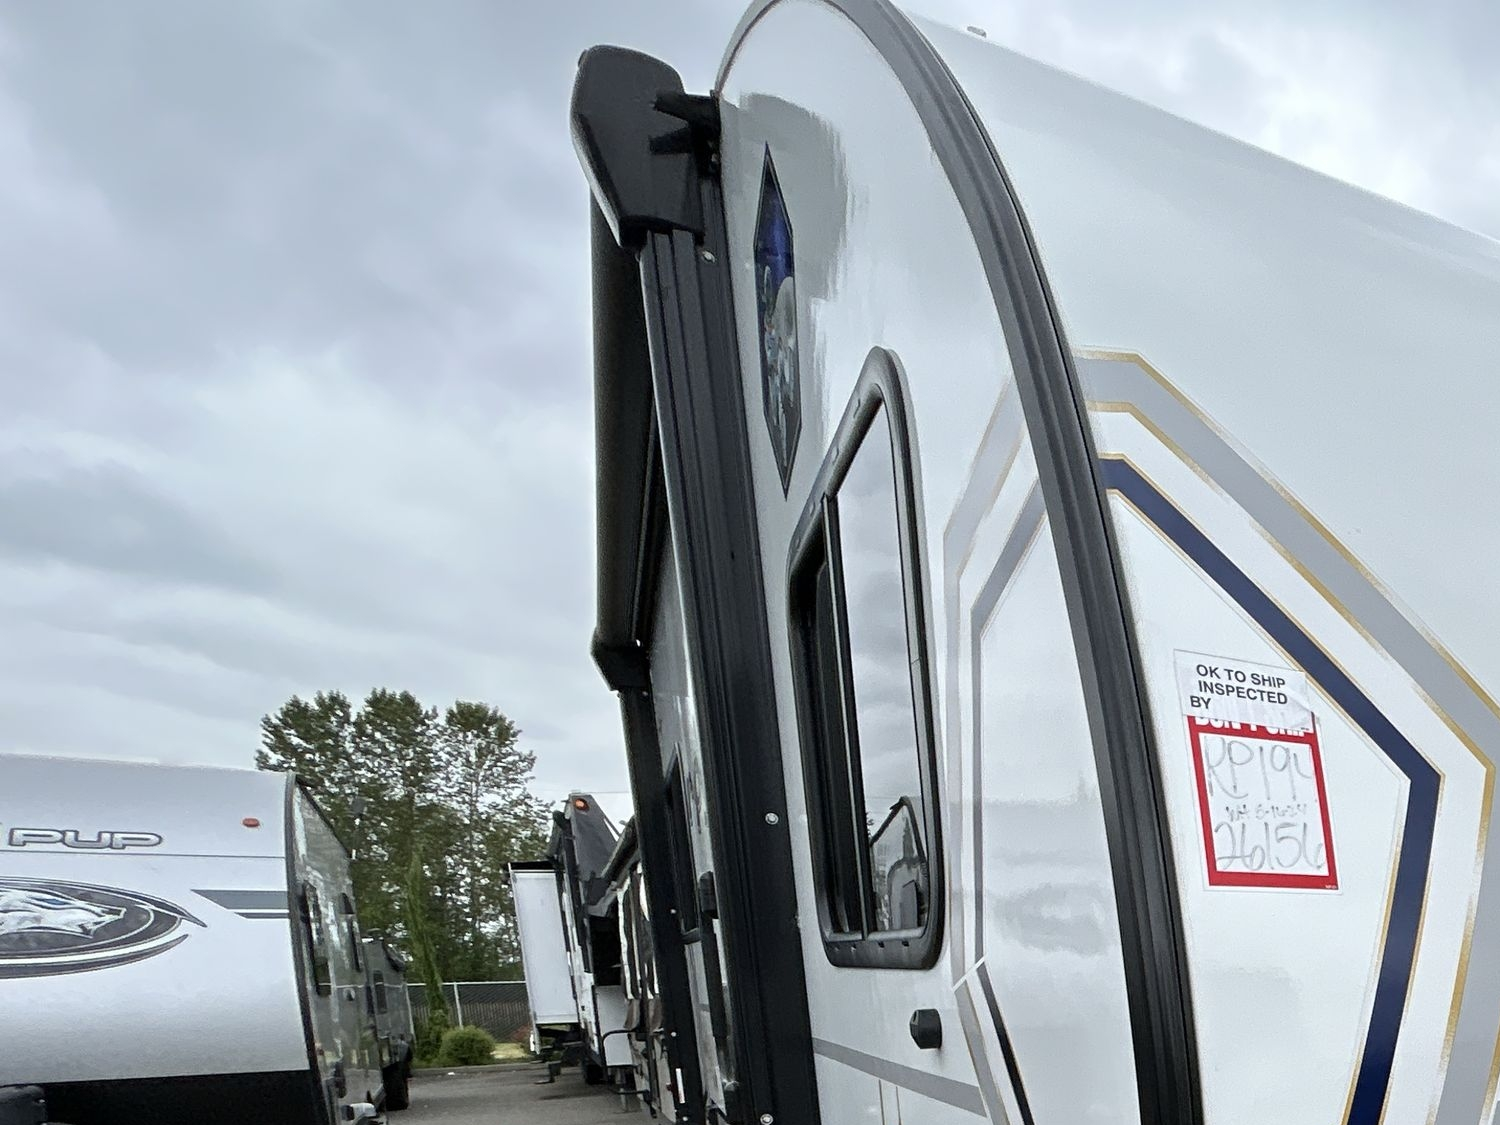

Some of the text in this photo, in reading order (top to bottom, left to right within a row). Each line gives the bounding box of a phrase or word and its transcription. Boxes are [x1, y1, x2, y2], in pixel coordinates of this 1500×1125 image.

[1196, 664, 1286, 689] OK TO SHIP
[1190, 695, 1211, 710] BY
[1198, 680, 1288, 705] INSPECTED
[8, 827, 163, 850] PUP
